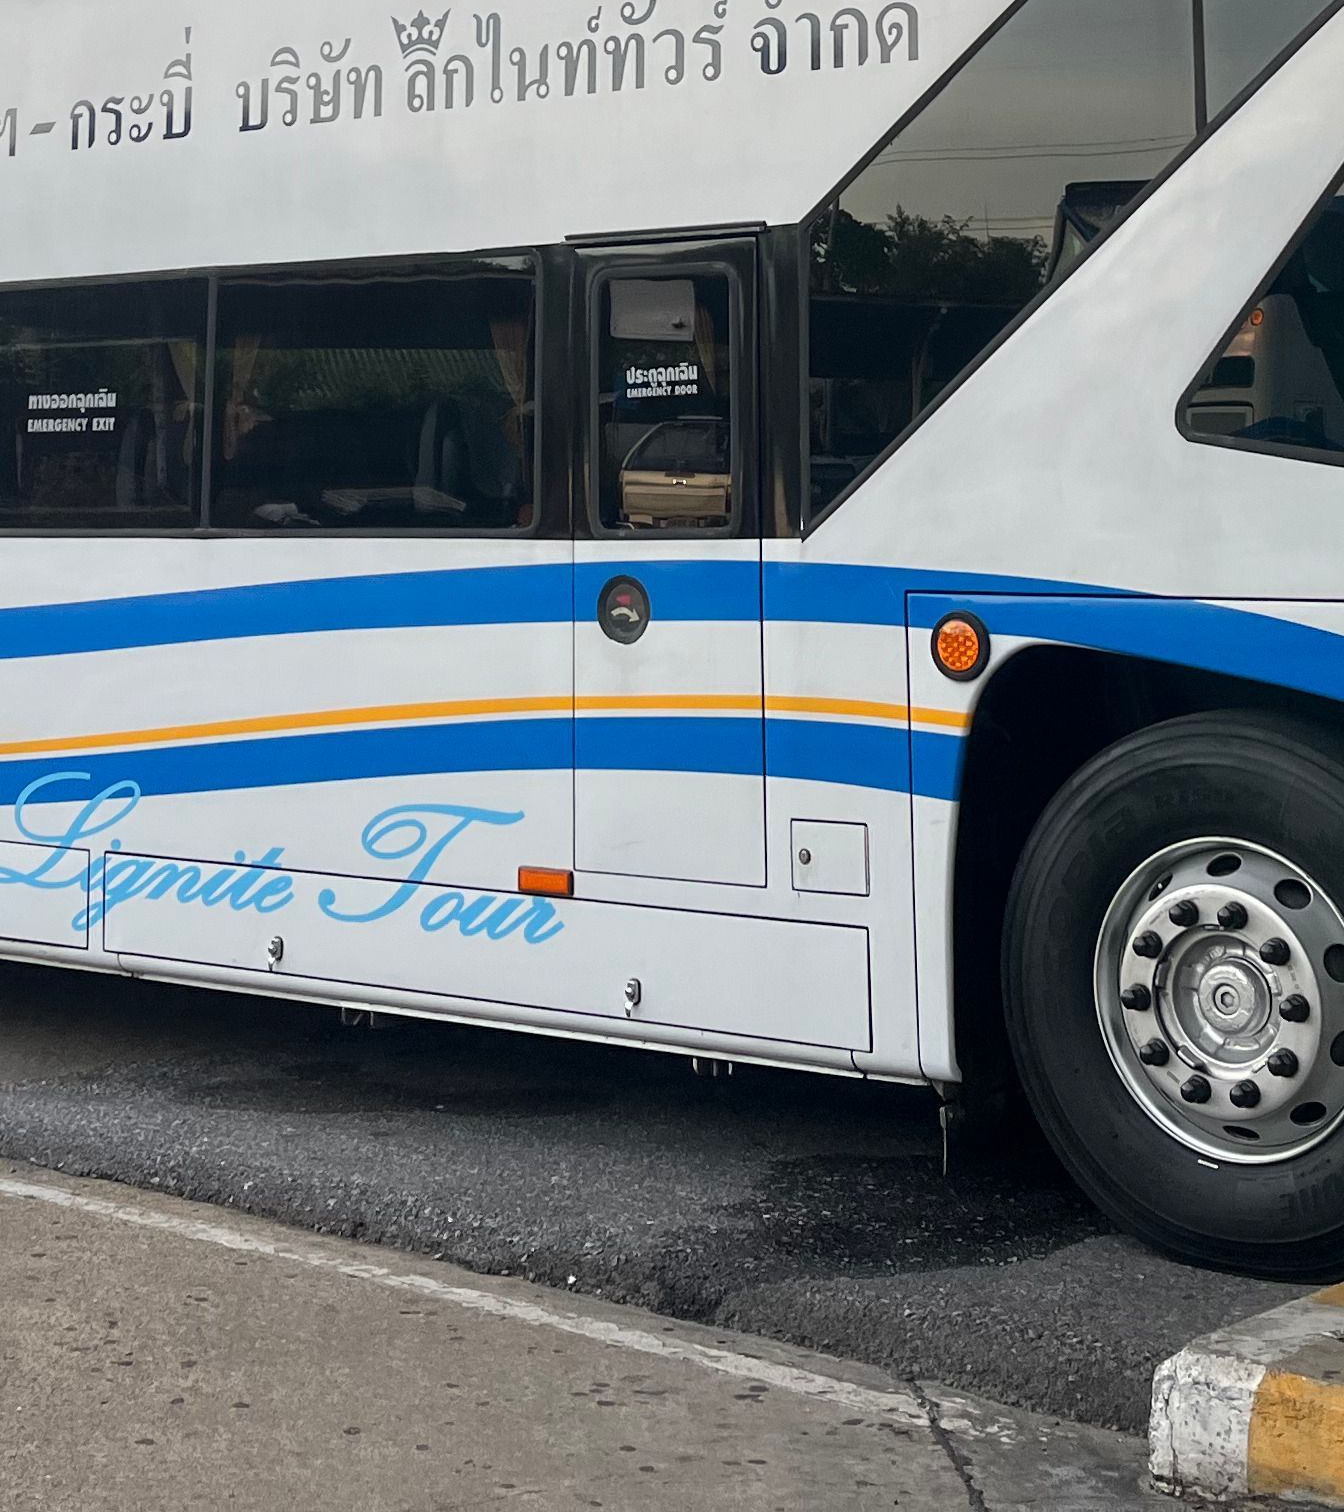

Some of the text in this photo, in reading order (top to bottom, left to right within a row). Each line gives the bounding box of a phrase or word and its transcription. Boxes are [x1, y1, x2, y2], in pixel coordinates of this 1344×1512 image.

[236, 37, 383, 132] บริษัท
[27, 388, 117, 413] ทางออกฉุกเฉิน
[626, 384, 698, 399] EMERGENCY DOOR
[27, 417, 116, 432] EMERGENCY EXIT
[317, 802, 565, 945] Tour
